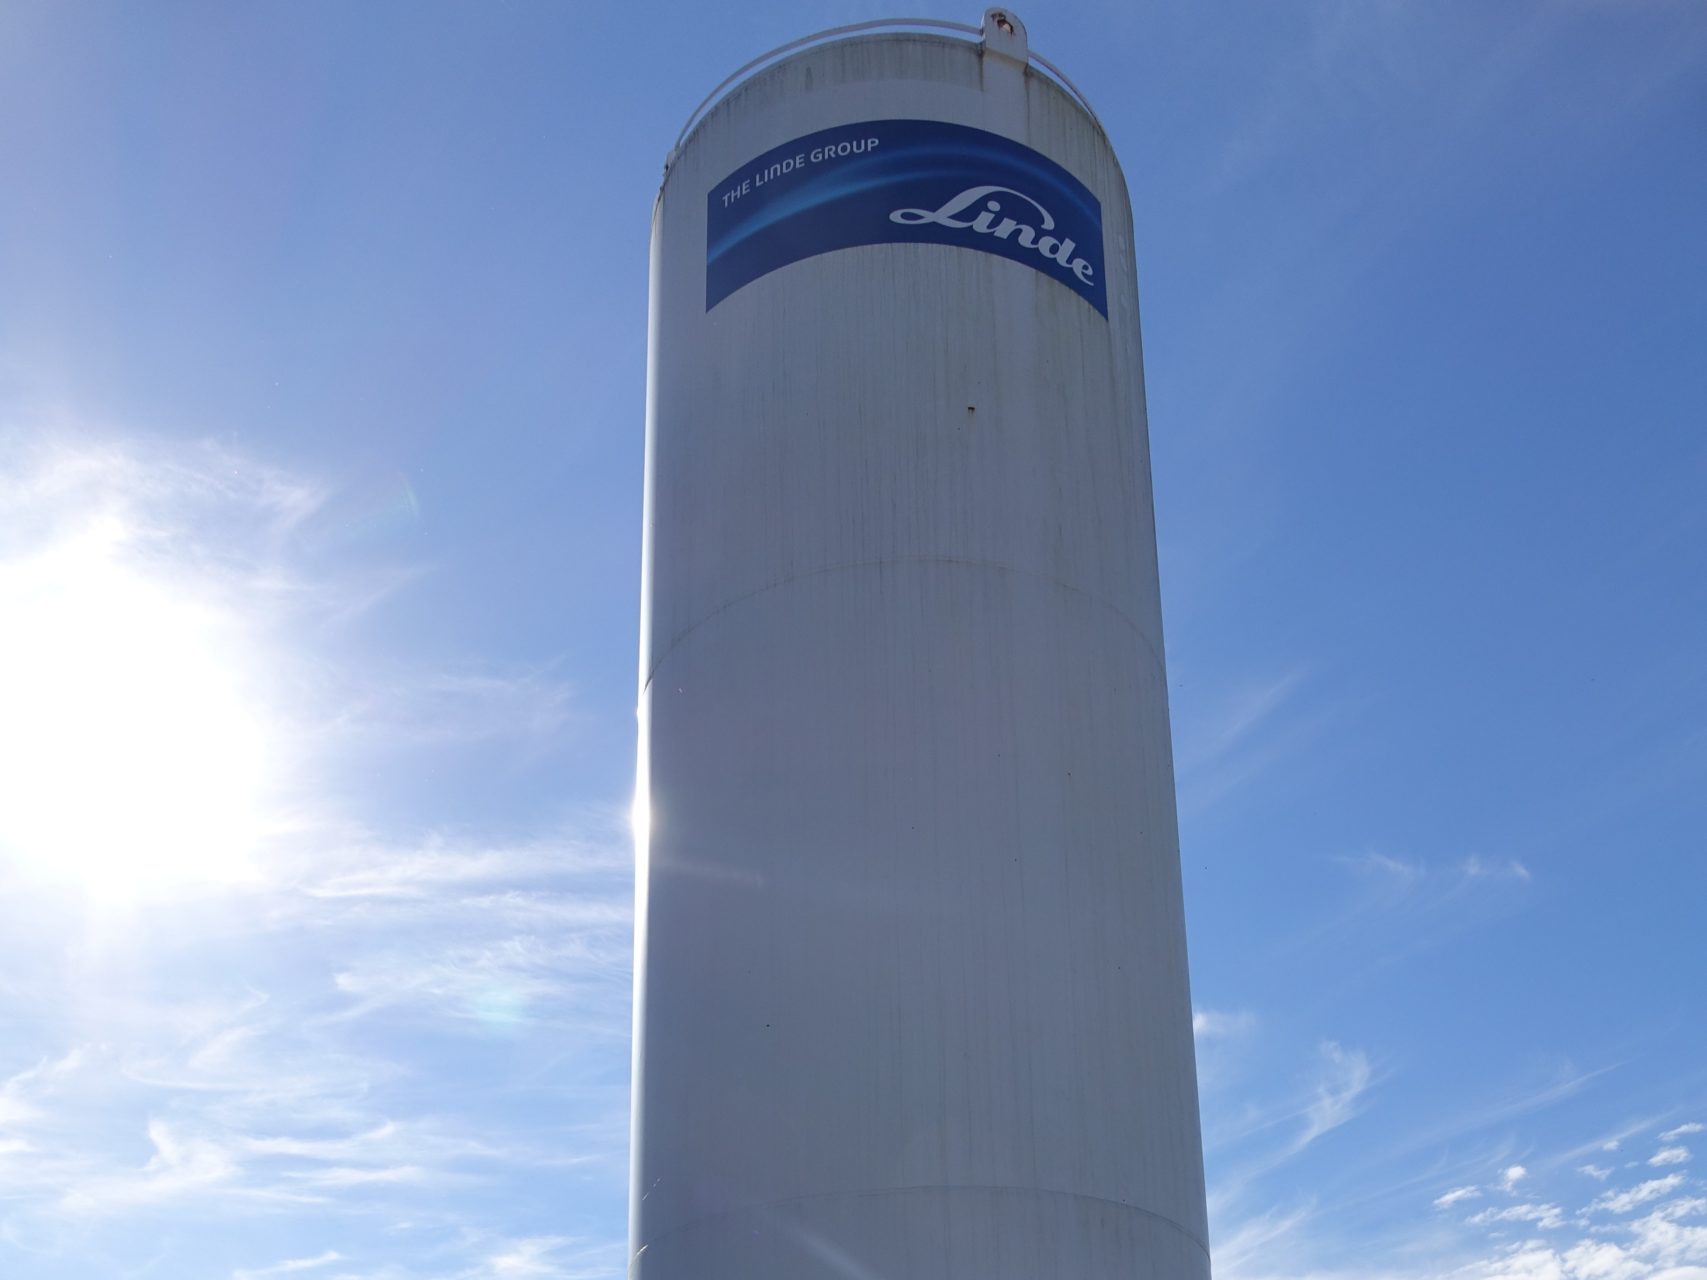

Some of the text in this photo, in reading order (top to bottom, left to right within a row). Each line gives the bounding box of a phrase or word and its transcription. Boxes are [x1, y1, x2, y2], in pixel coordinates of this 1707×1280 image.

[722, 138, 879, 208] THE LINDE GROUP
[889, 185, 1095, 286] Linde
